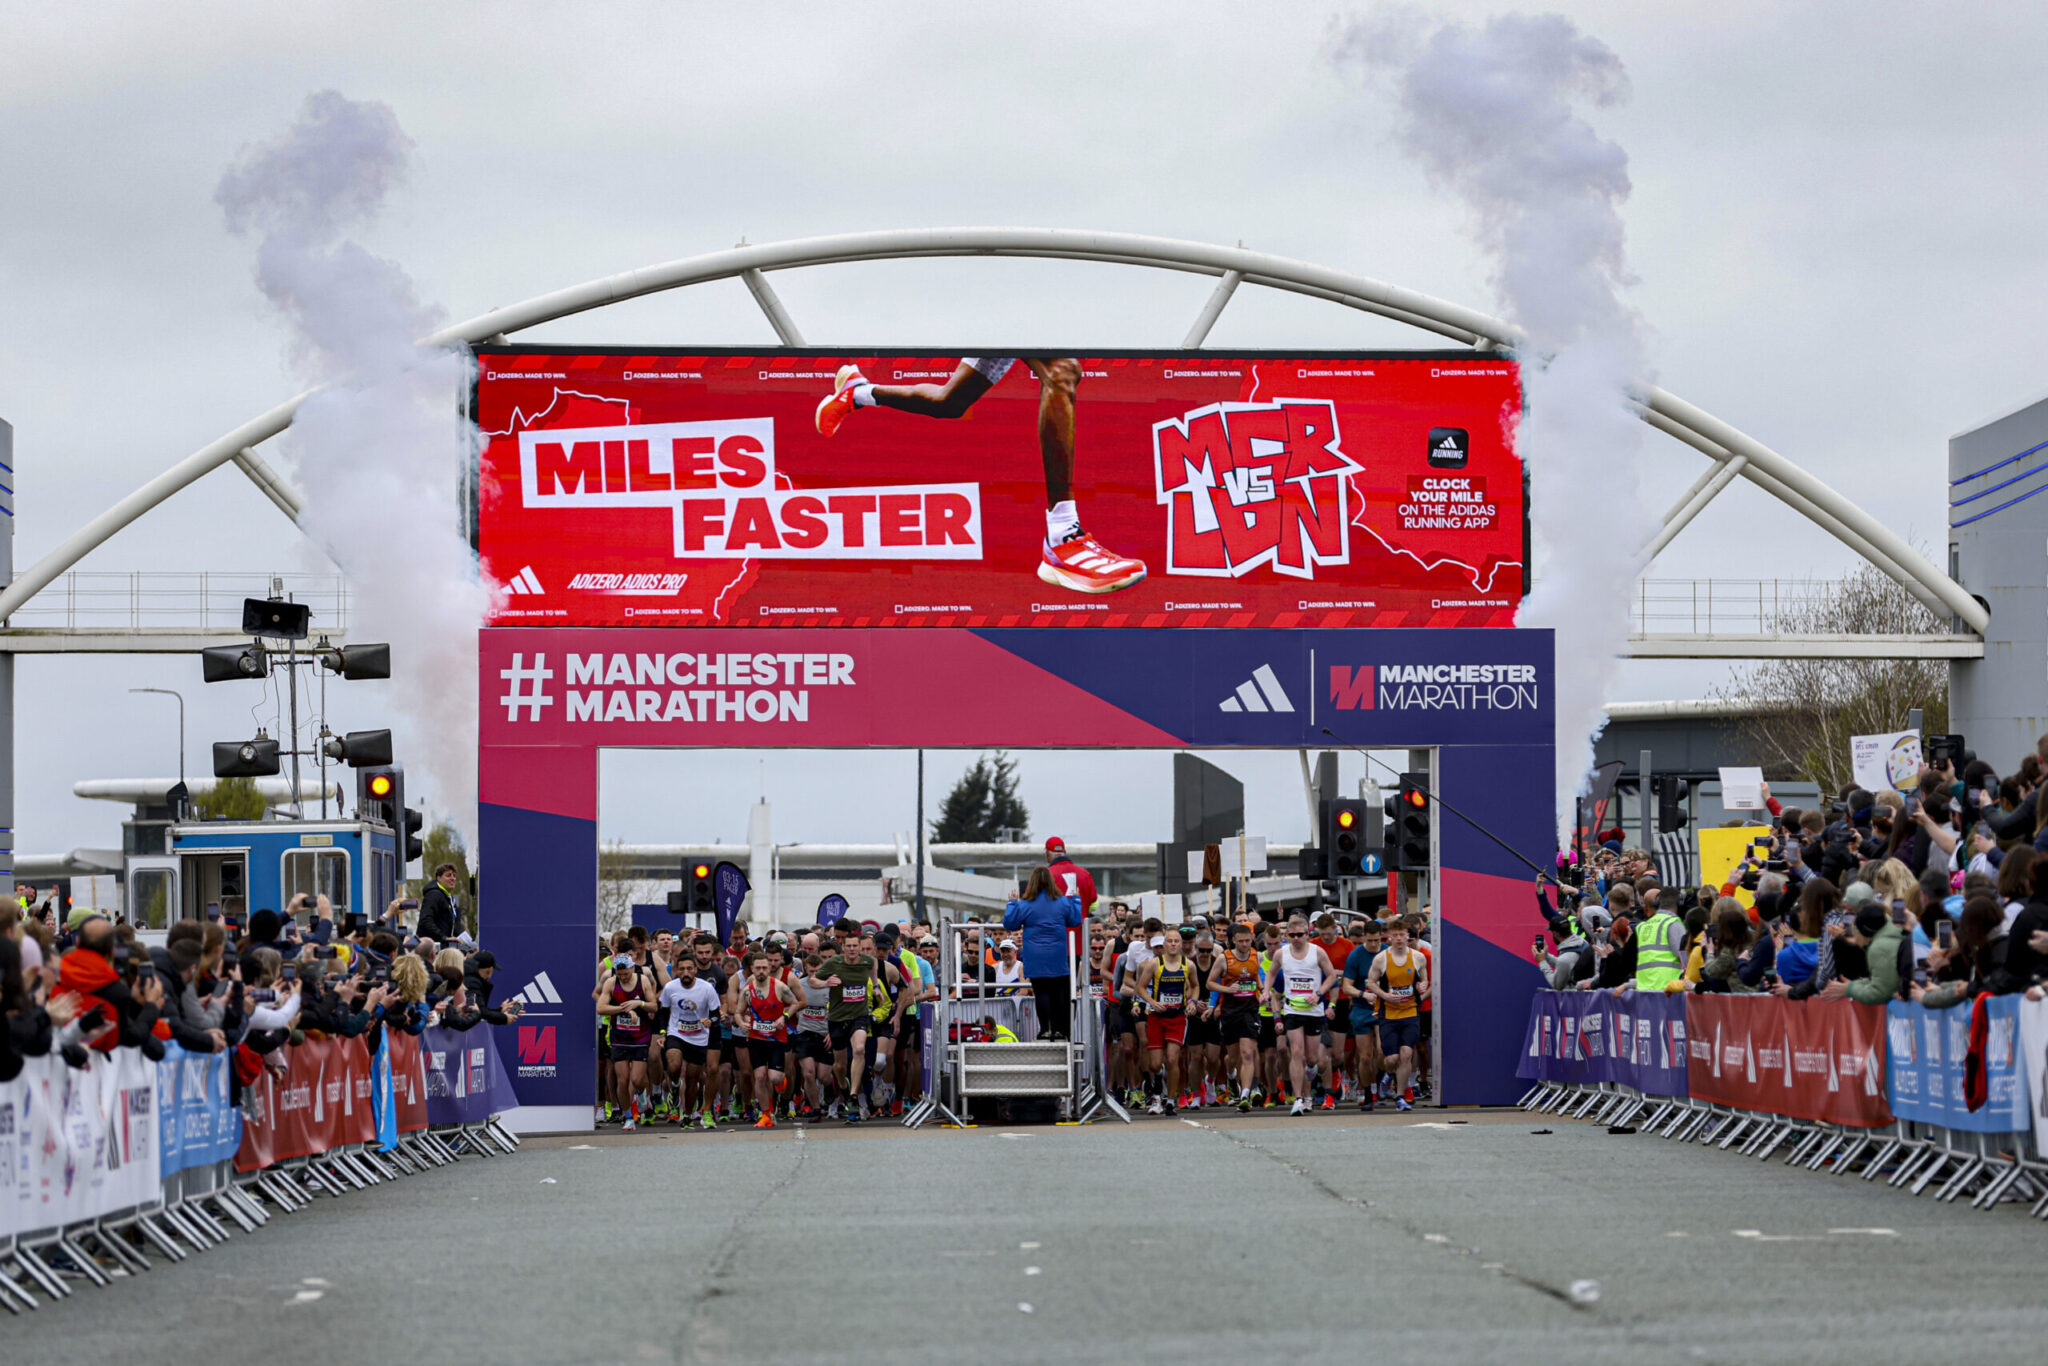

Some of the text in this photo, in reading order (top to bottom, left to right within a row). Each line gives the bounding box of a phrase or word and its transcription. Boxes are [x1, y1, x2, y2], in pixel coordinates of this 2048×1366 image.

[1432, 449, 1464, 460] RUNNING
[535, 435, 767, 496] MILES
[1422, 478, 1471, 490] CLOCK
[1410, 491, 1484, 503] YOUR MILE
[1398, 504, 1496, 517] ON THE ADIDAS
[682, 493, 976, 551] FASTER
[1404, 517, 1490, 529] RUNNING APP
[567, 574, 689, 589] ADIZERO ADIOS PRO
[566, 653, 856, 685] MANCHESTER
[1380, 665, 1536, 683] MANCHESTER
[1380, 685, 1537, 710] MARATHON
[566, 690, 809, 722] MARATHON
